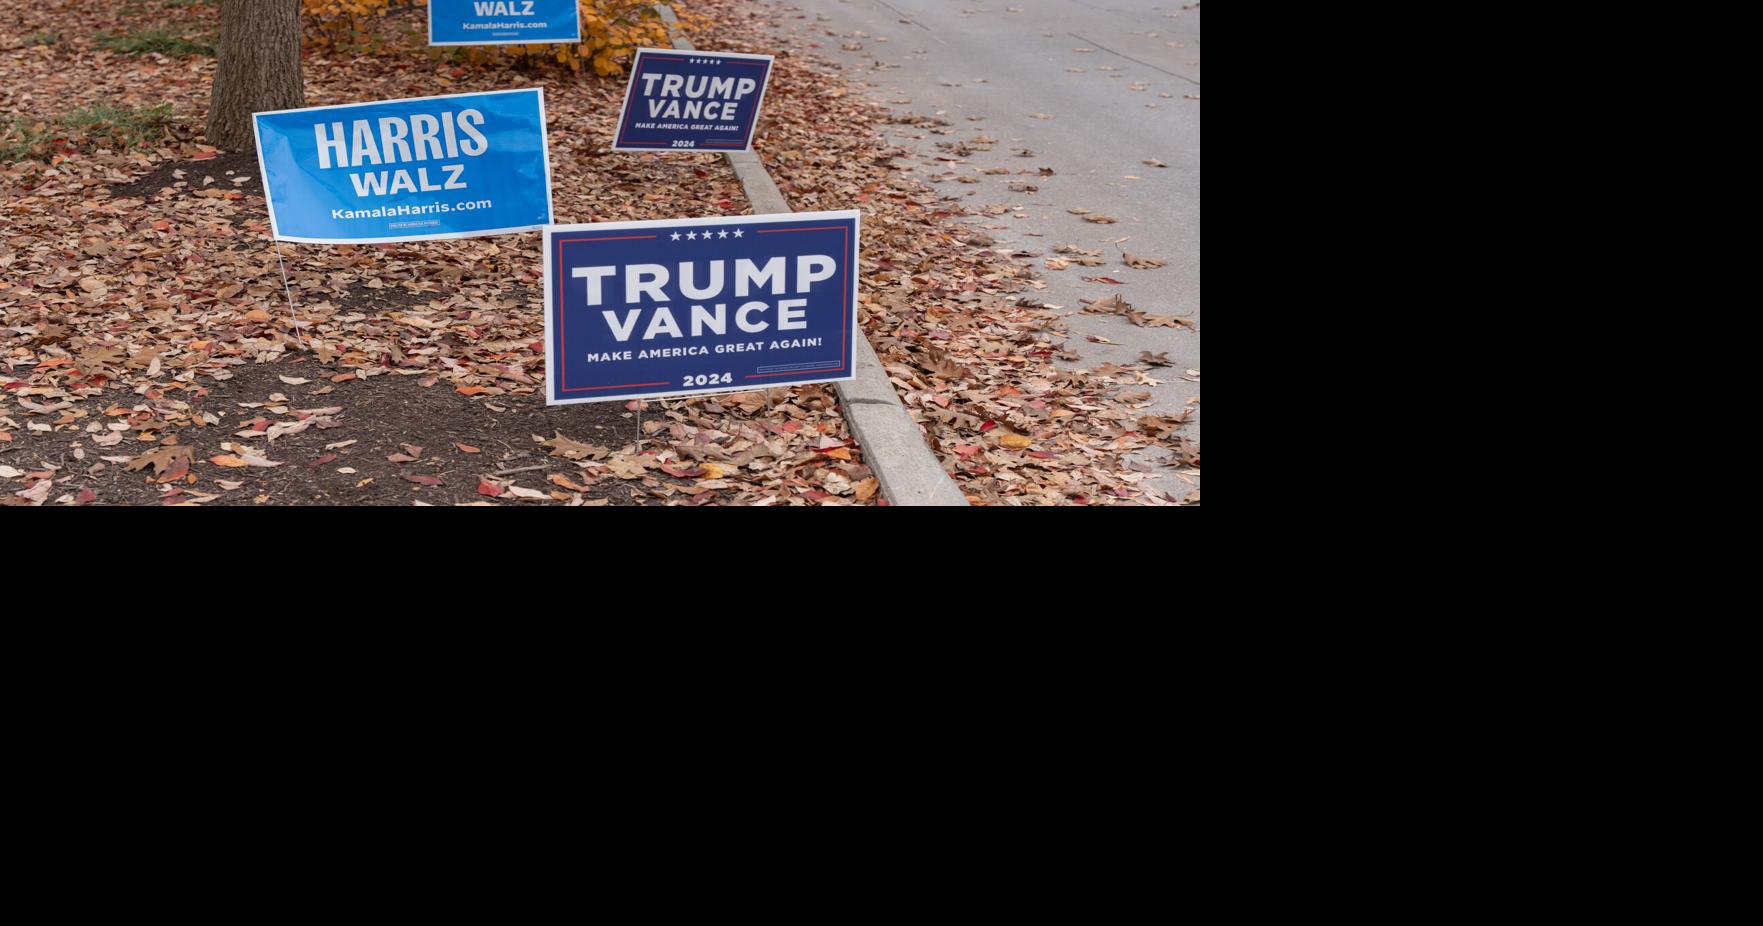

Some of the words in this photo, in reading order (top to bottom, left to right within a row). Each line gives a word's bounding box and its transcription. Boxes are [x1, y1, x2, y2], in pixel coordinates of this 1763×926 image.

[474, 1, 535, 16] WALZ
[463, 21, 547, 30] KamalaHarris.com
[642, 72, 756, 100] TRUMP
[648, 99, 738, 120] VANCE
[313, 108, 489, 169] HARRIS
[672, 140, 695, 148] 2024
[350, 163, 466, 197] WALZ
[332, 198, 492, 220] KamalaHarris.com
[571, 254, 837, 306] TRUMP
[602, 298, 807, 342] VANCE
[587, 350, 632, 363] MAKE
[638, 345, 709, 360] AMERICA
[715, 341, 764, 354] GREAT
[769, 337, 823, 350] AGAIN!
[682, 372, 733, 387] 2024
